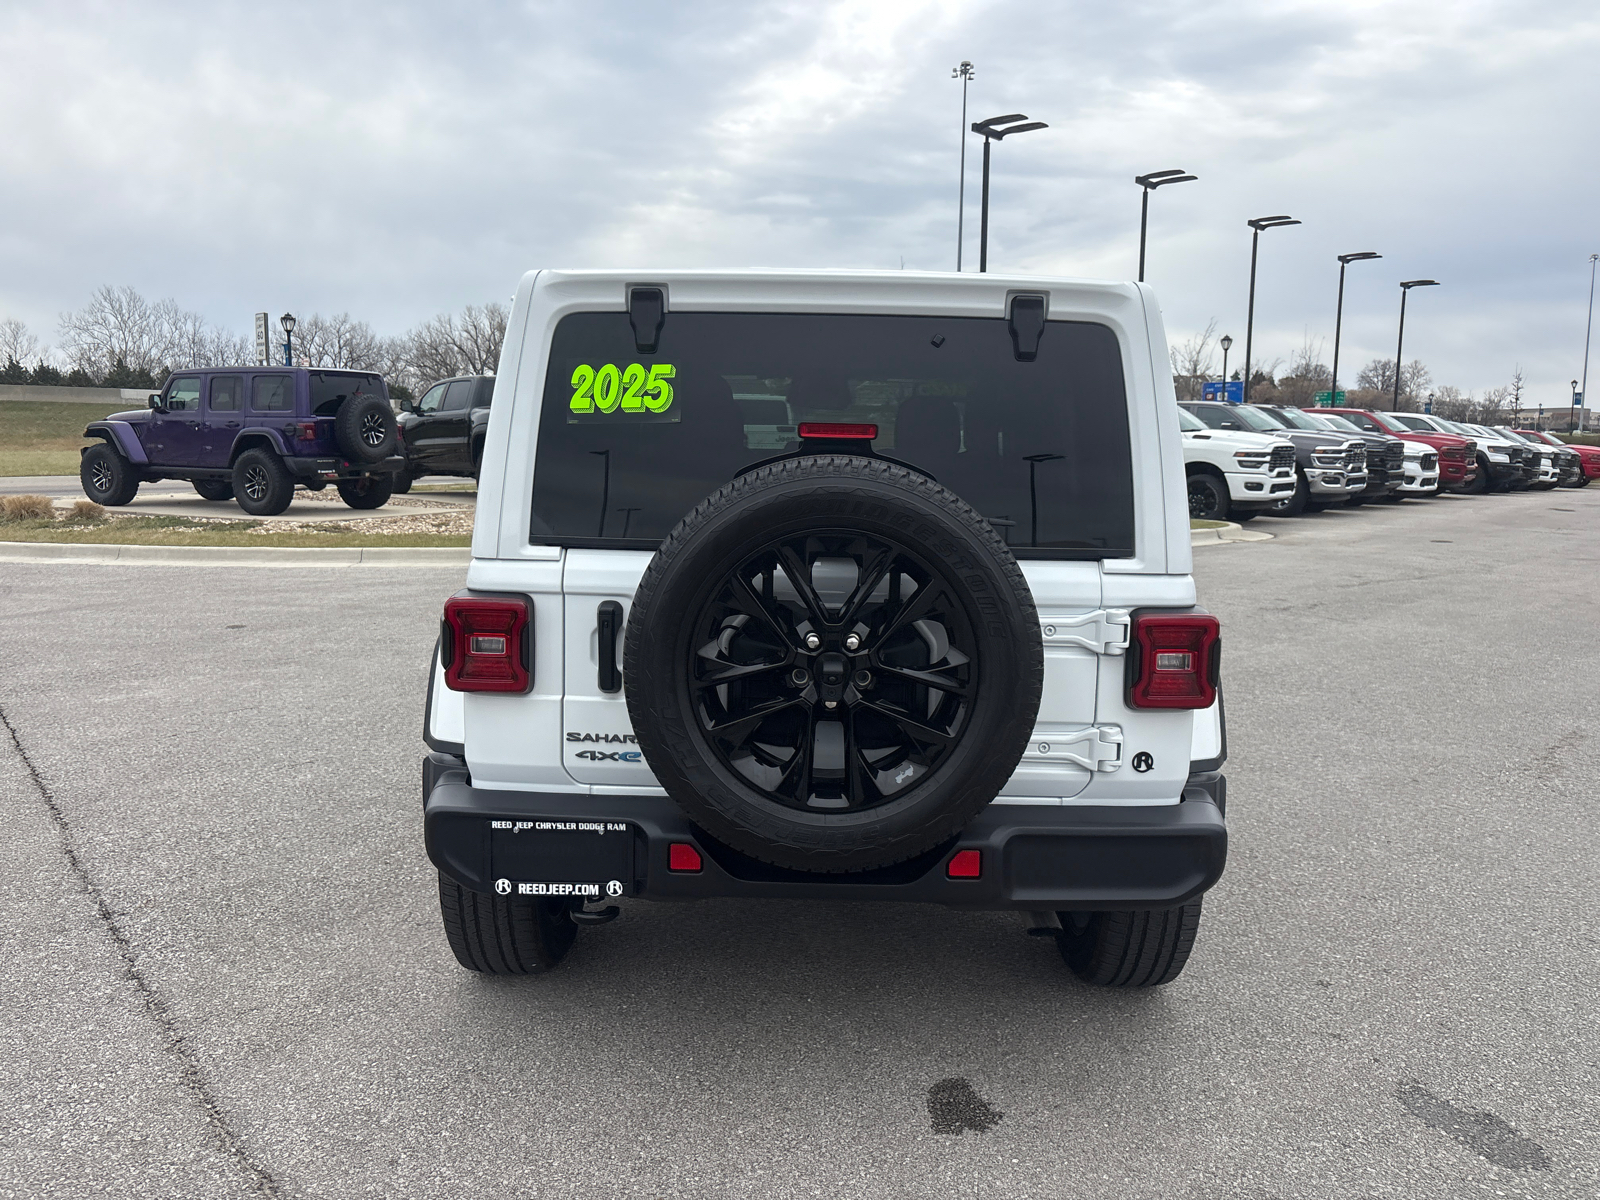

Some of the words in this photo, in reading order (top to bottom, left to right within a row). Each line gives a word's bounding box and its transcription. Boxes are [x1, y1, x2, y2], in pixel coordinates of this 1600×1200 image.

[569, 362, 677, 414] 2025
[566, 732, 640, 744] SAHAR
[491, 821, 512, 829] REED
[513, 821, 533, 830] JEEP
[535, 822, 577, 830] CHRYSLER
[578, 823, 605, 831] DODGE
[607, 823, 627, 831] RAM
[518, 883, 599, 896] REEDJEEP.COM
